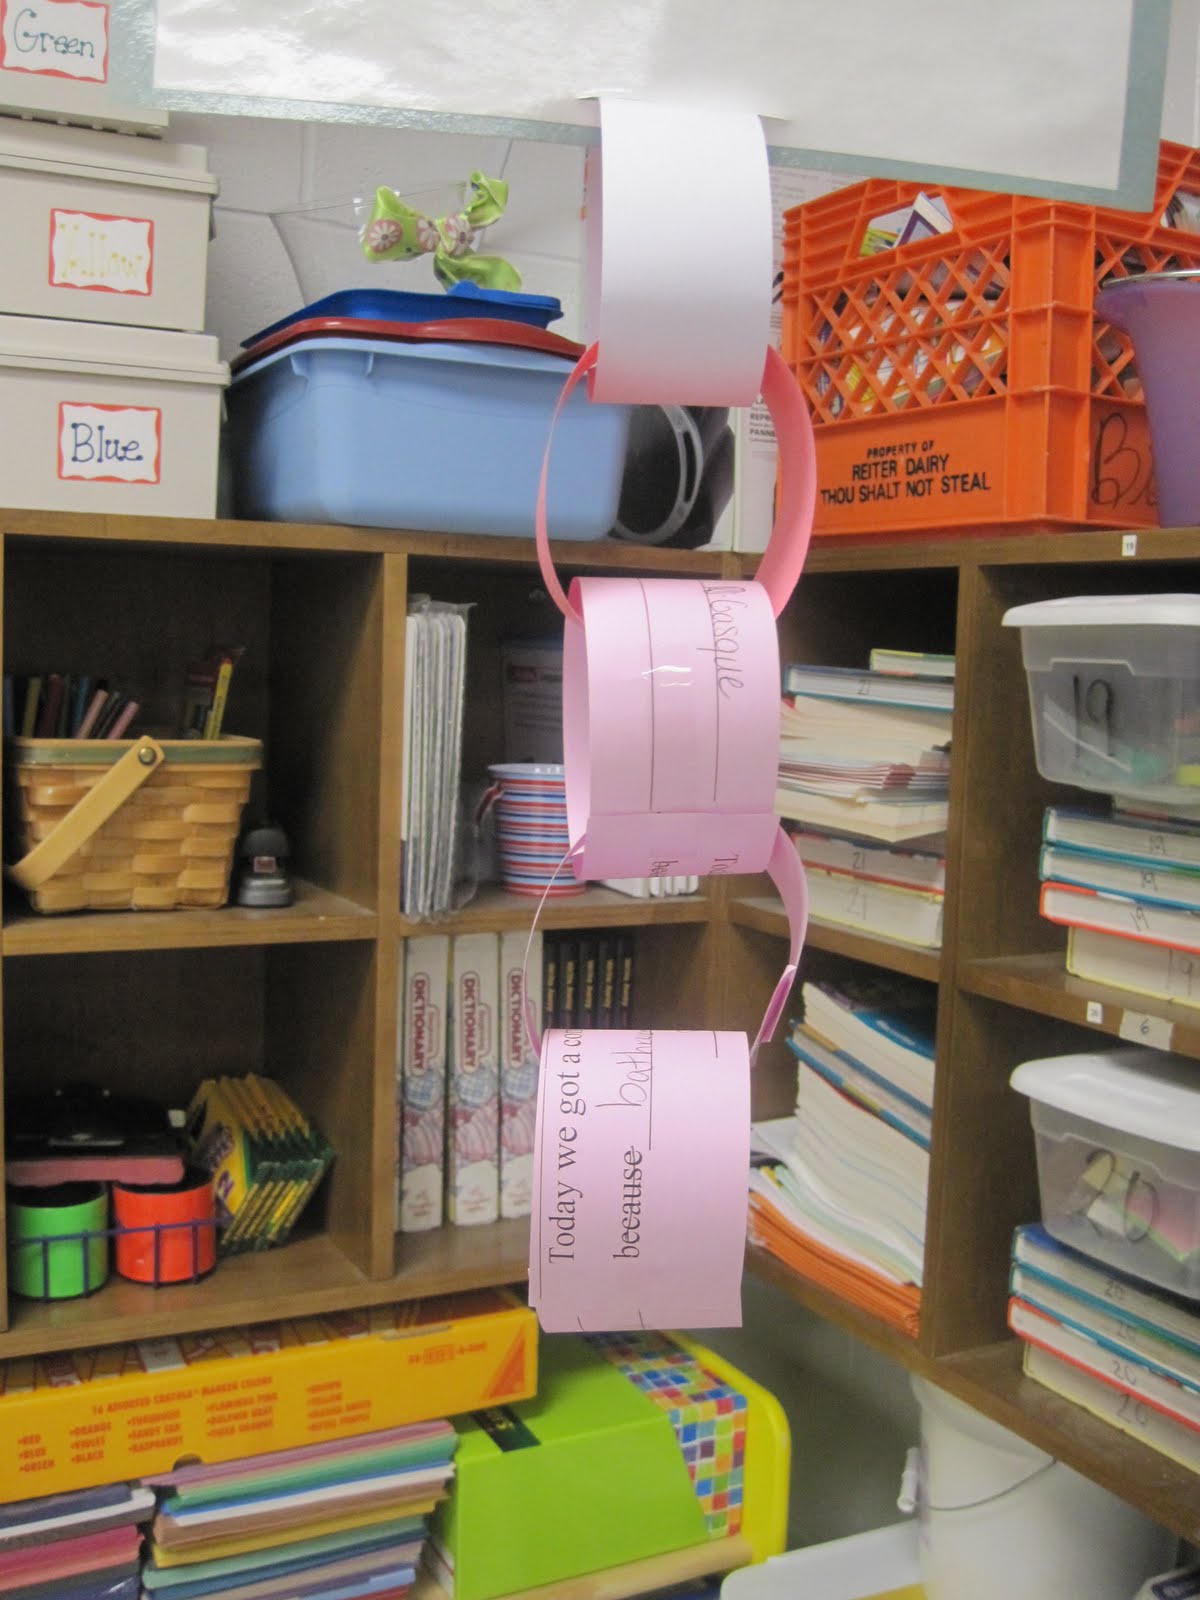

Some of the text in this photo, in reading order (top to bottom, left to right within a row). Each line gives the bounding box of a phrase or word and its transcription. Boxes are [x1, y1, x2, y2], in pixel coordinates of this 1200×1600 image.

[13, 8, 94, 58] Green
[71, 422, 143, 462] Blue
[867, 440, 934, 458] PROPERTY OF
[820, 472, 990, 505] THOU SHALT NOT STEAL
[852, 454, 949, 480] REITER DAIRY
[1073, 674, 1115, 759] 19
[414, 979, 426, 1069] DICTIONARY
[464, 978, 476, 1067] DICTIONARY
[511, 975, 522, 1062] DICTIONARY
[1140, 1018, 1150, 1035] 6
[562, 1054, 581, 1064] a
[556, 1072, 586, 1116] got
[557, 1127, 578, 1170] we
[549, 1181, 583, 1263] Today
[613, 1145, 643, 1259] because
